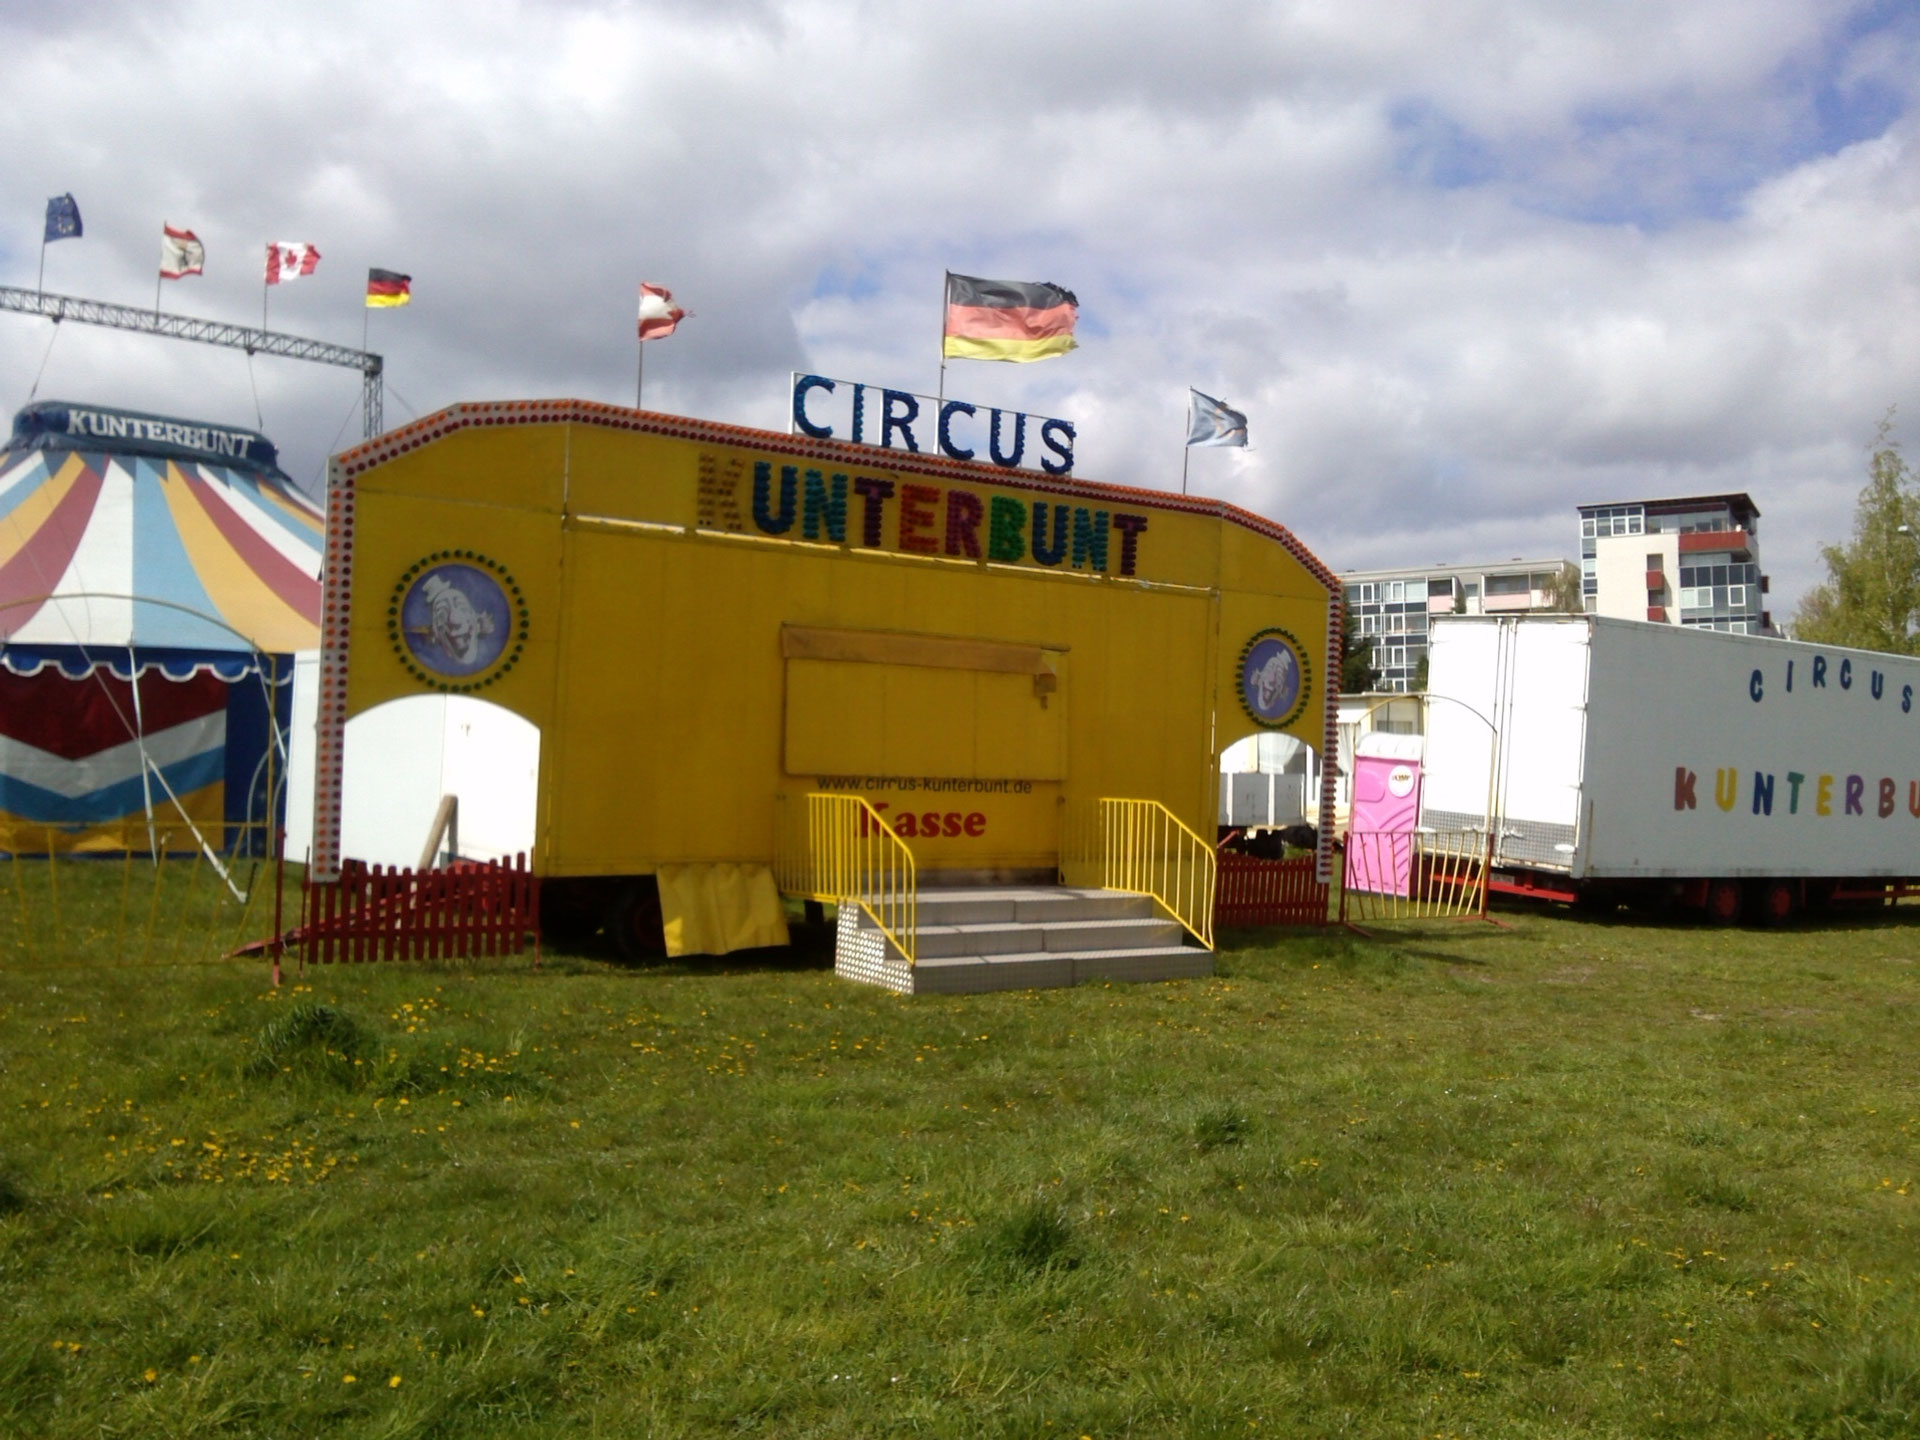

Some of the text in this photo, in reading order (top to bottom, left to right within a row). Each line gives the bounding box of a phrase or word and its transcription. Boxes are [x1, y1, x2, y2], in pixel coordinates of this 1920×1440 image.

[68, 409, 254, 459] KUNTERBUNT
[793, 375, 1077, 474] CIRCUS
[1750, 655, 1913, 714] CIRCUS
[854, 802, 987, 838] Kasse
